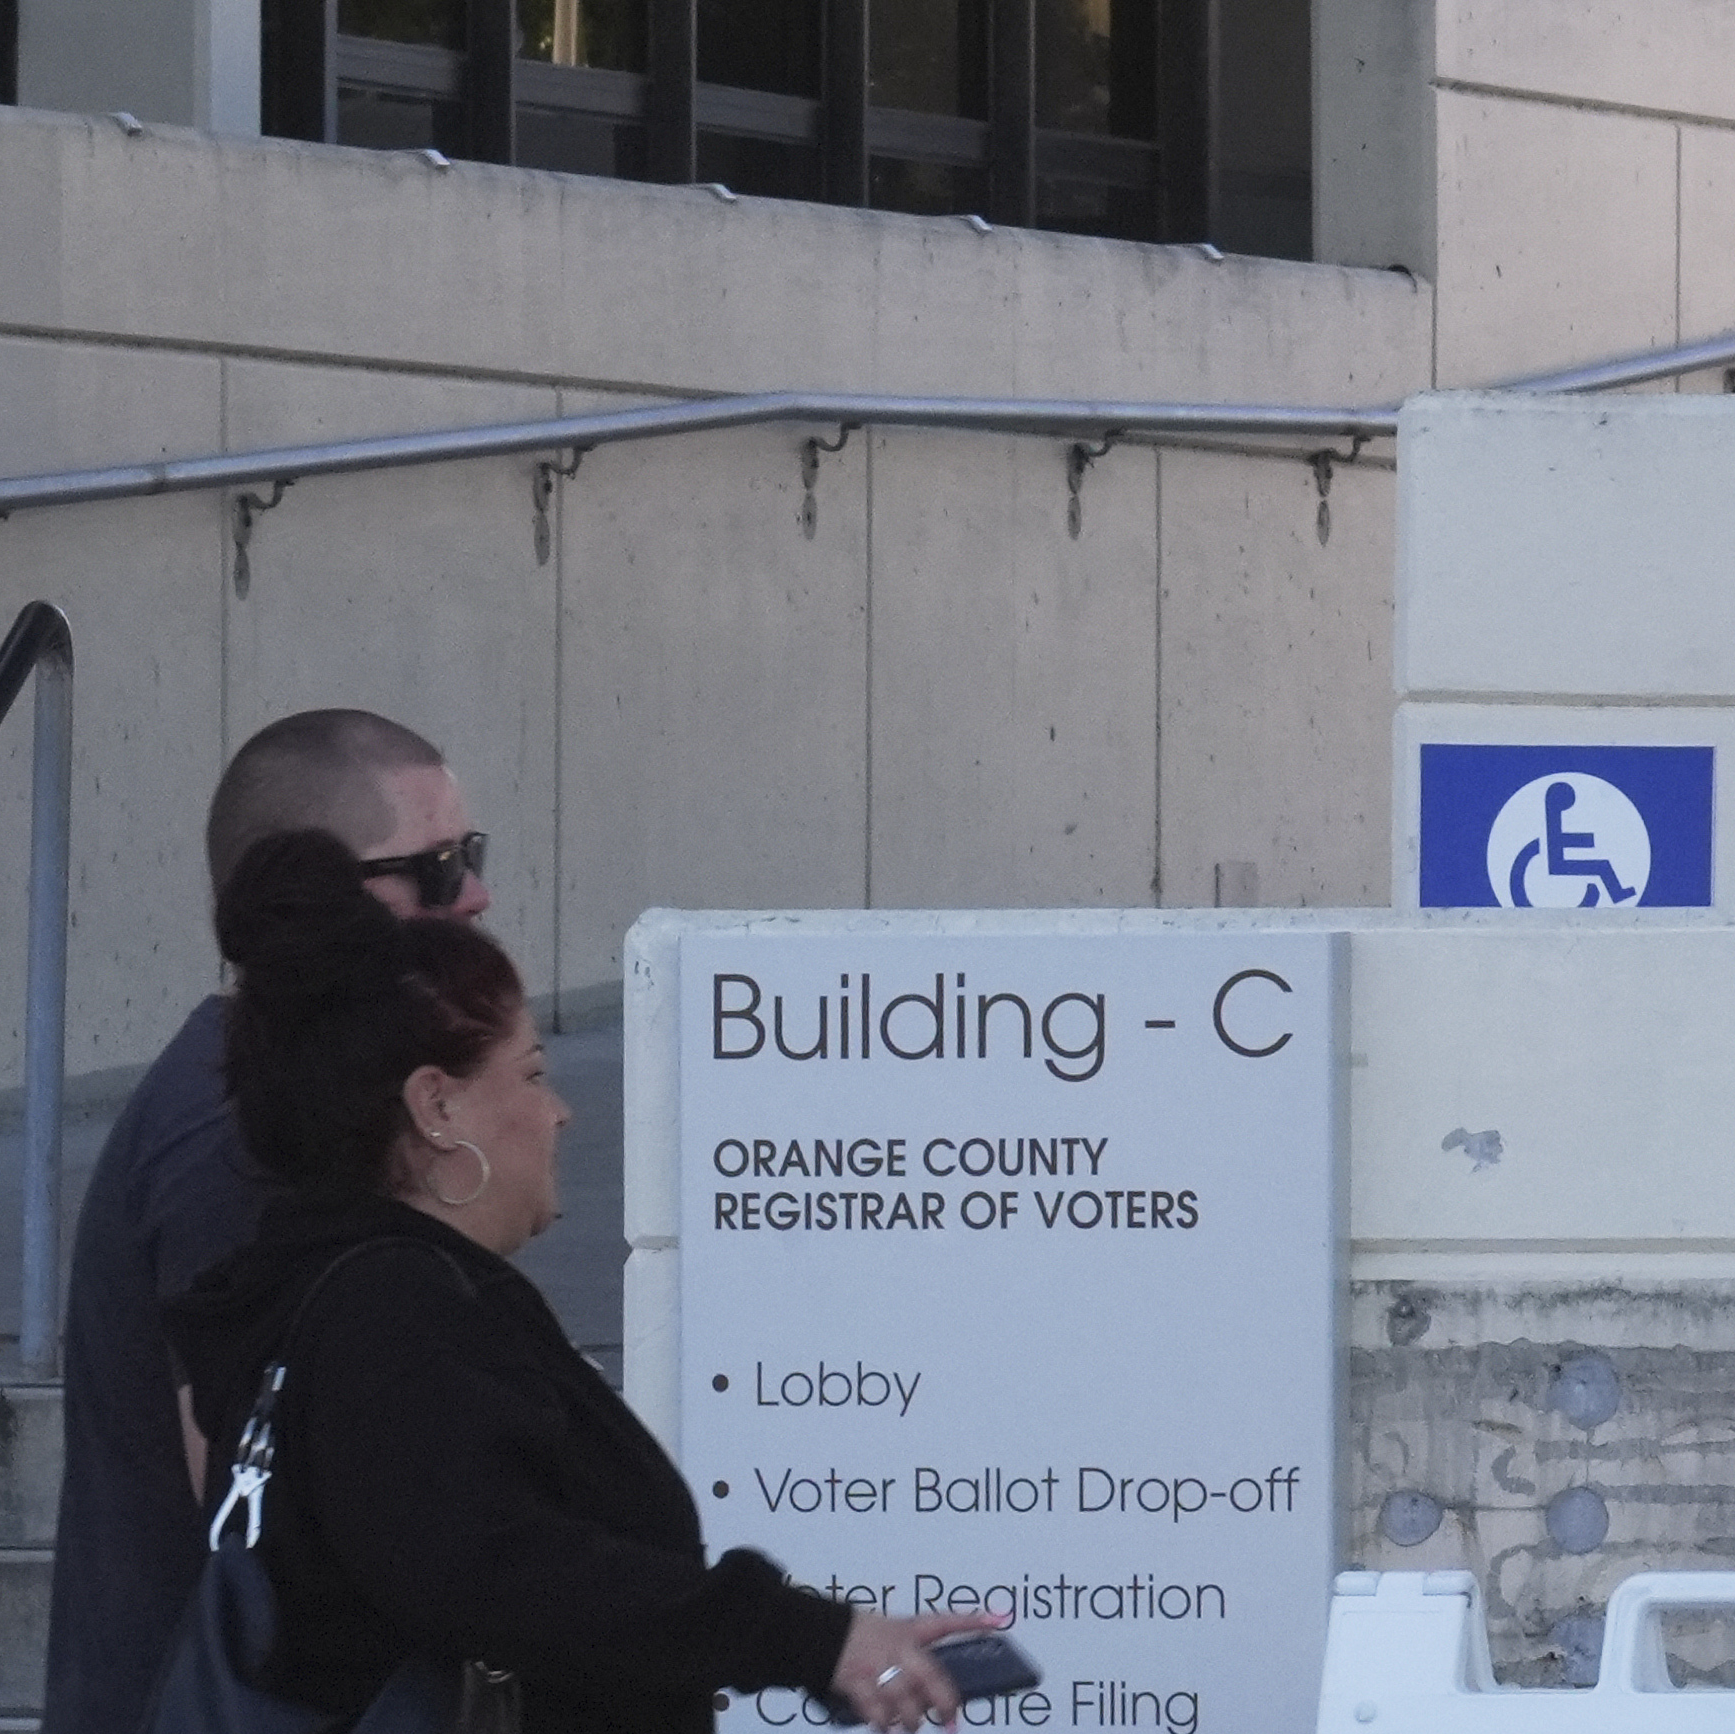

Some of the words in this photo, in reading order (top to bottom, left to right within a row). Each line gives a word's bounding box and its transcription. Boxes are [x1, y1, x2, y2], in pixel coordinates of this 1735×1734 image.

[713, 972, 1105, 1083] Building
[1144, 1019, 1176, 1029] -
[1212, 968, 1293, 1058] C
[713, 1138, 906, 1178] ORANGE
[922, 1137, 1109, 1177] COUNTY
[714, 1191, 946, 1232] REGISTRAR
[960, 1190, 1019, 1230] OF
[1033, 1189, 1199, 1230] VOTERS
[756, 1360, 922, 1417] Lobby
[754, 1467, 896, 1513] Voter
[915, 1467, 1060, 1513] Ballot
[1078, 1466, 1300, 1524] Drop-off
[913, 1573, 1227, 1631] Registration
